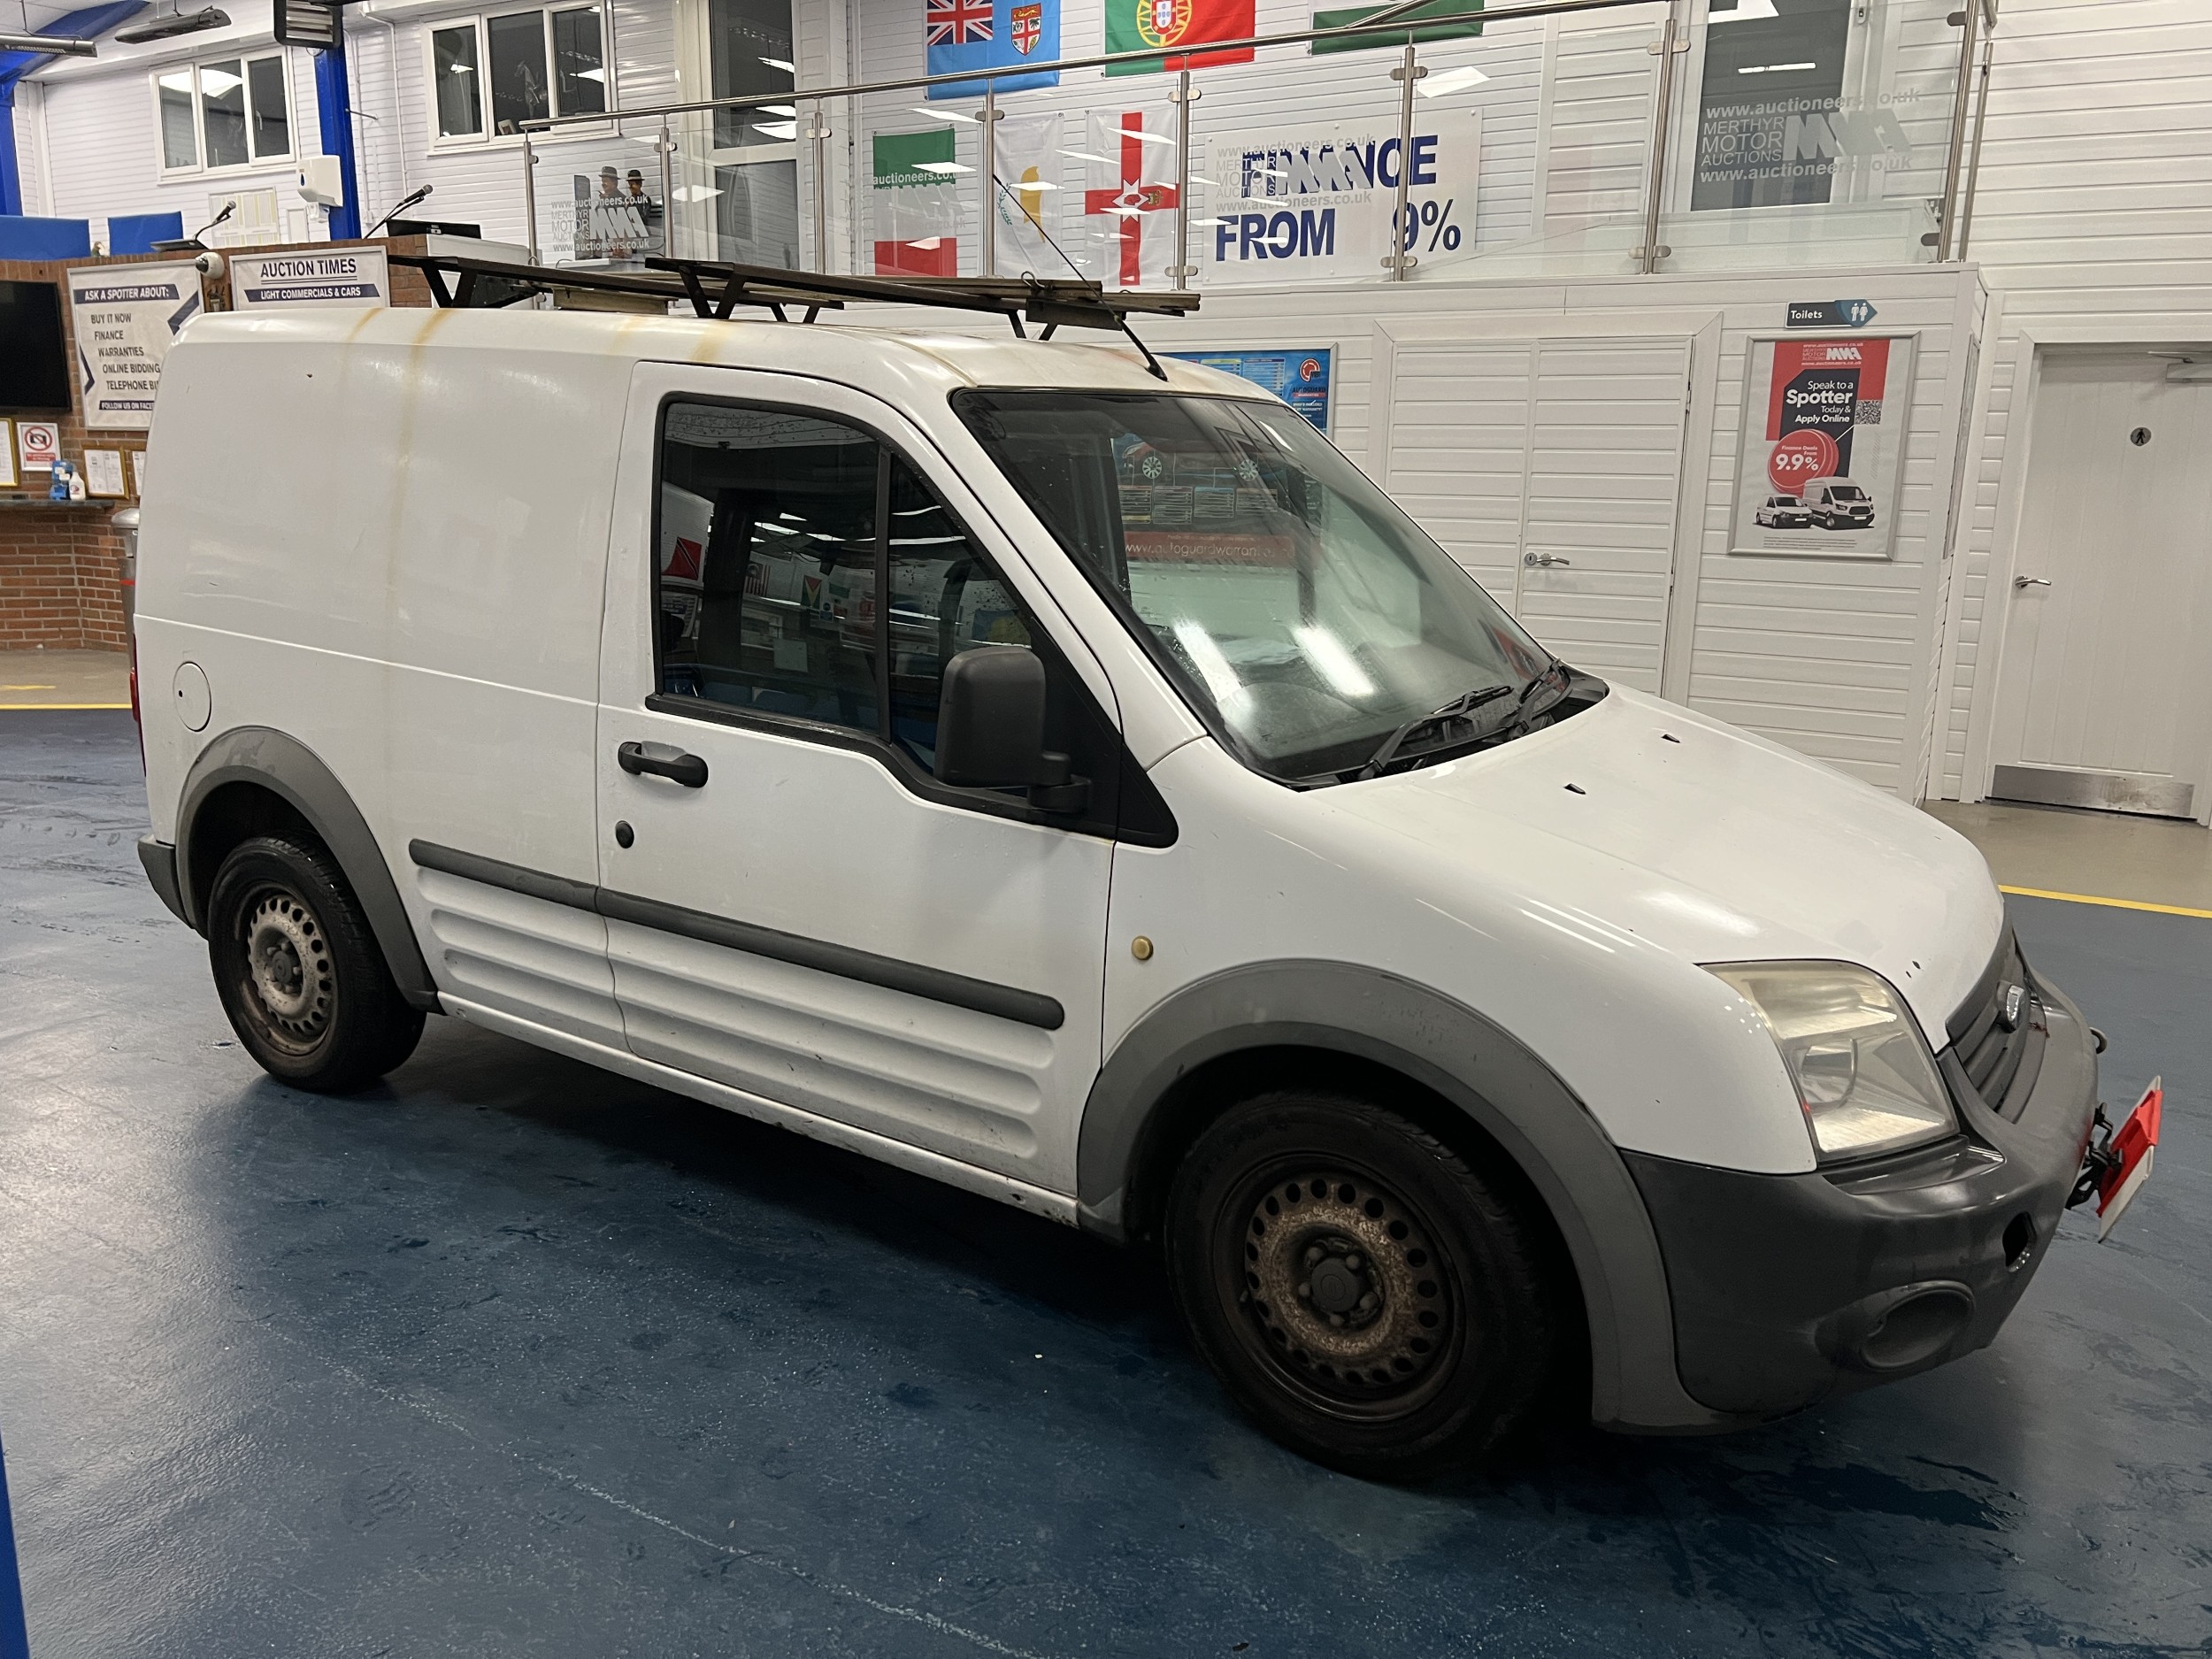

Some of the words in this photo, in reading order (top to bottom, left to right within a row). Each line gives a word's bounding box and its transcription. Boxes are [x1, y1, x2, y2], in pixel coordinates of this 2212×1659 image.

[1706, 88, 1921, 119] www.auctioneerso.uk
[1704, 116, 1785, 135] MERTHYR
[1217, 134, 1374, 158] www.auctioneers.co.uk
[1701, 131, 1783, 154] MOTOR
[1701, 149, 1782, 166] AUCTIONS
[1700, 154, 1912, 182] www.auctioneerso.uk
[1216, 185, 1276, 198] AUCTIONS
[551, 196, 649, 208] www.auctneers.co.uk
[551, 209, 589, 219] MERTHYR
[551, 219, 589, 233] MOTOR
[1216, 208, 1336, 262] FROM
[553, 239, 649, 252] www.auctioneers.co.uk
[260, 260, 314, 278] AUCTION
[317, 258, 357, 275] TIMES
[84, 289, 99, 301] ASK
[100, 289, 105, 300] A
[107, 288, 139, 300] SPOTTER
[140, 286, 169, 298] ABOUT:
[260, 289, 280, 300] LIGHT
[280, 288, 333, 299] COMMERCIALS
[334, 288, 340, 297] &
[341, 287, 361, 297] CARS
[91, 314, 105, 324] BUY
[107, 314, 113, 324] IT
[115, 313, 131, 323] NOW
[1791, 310, 1823, 319] Toilets
[94, 330, 124, 341] FINANCE
[97, 346, 144, 357] WARRANTIES
[102, 364, 129, 373] ONLINE
[130, 363, 161, 373] BIDDING
[106, 380, 148, 390] TELEPHONE
[1808, 380, 1835, 391] Speak
[1786, 389, 1853, 408] Spotter
[1821, 405, 1844, 415] Today
[1794, 414, 1820, 425] Apply
[1822, 414, 1850, 423] Online
[1775, 453, 1819, 471] 9.9%
